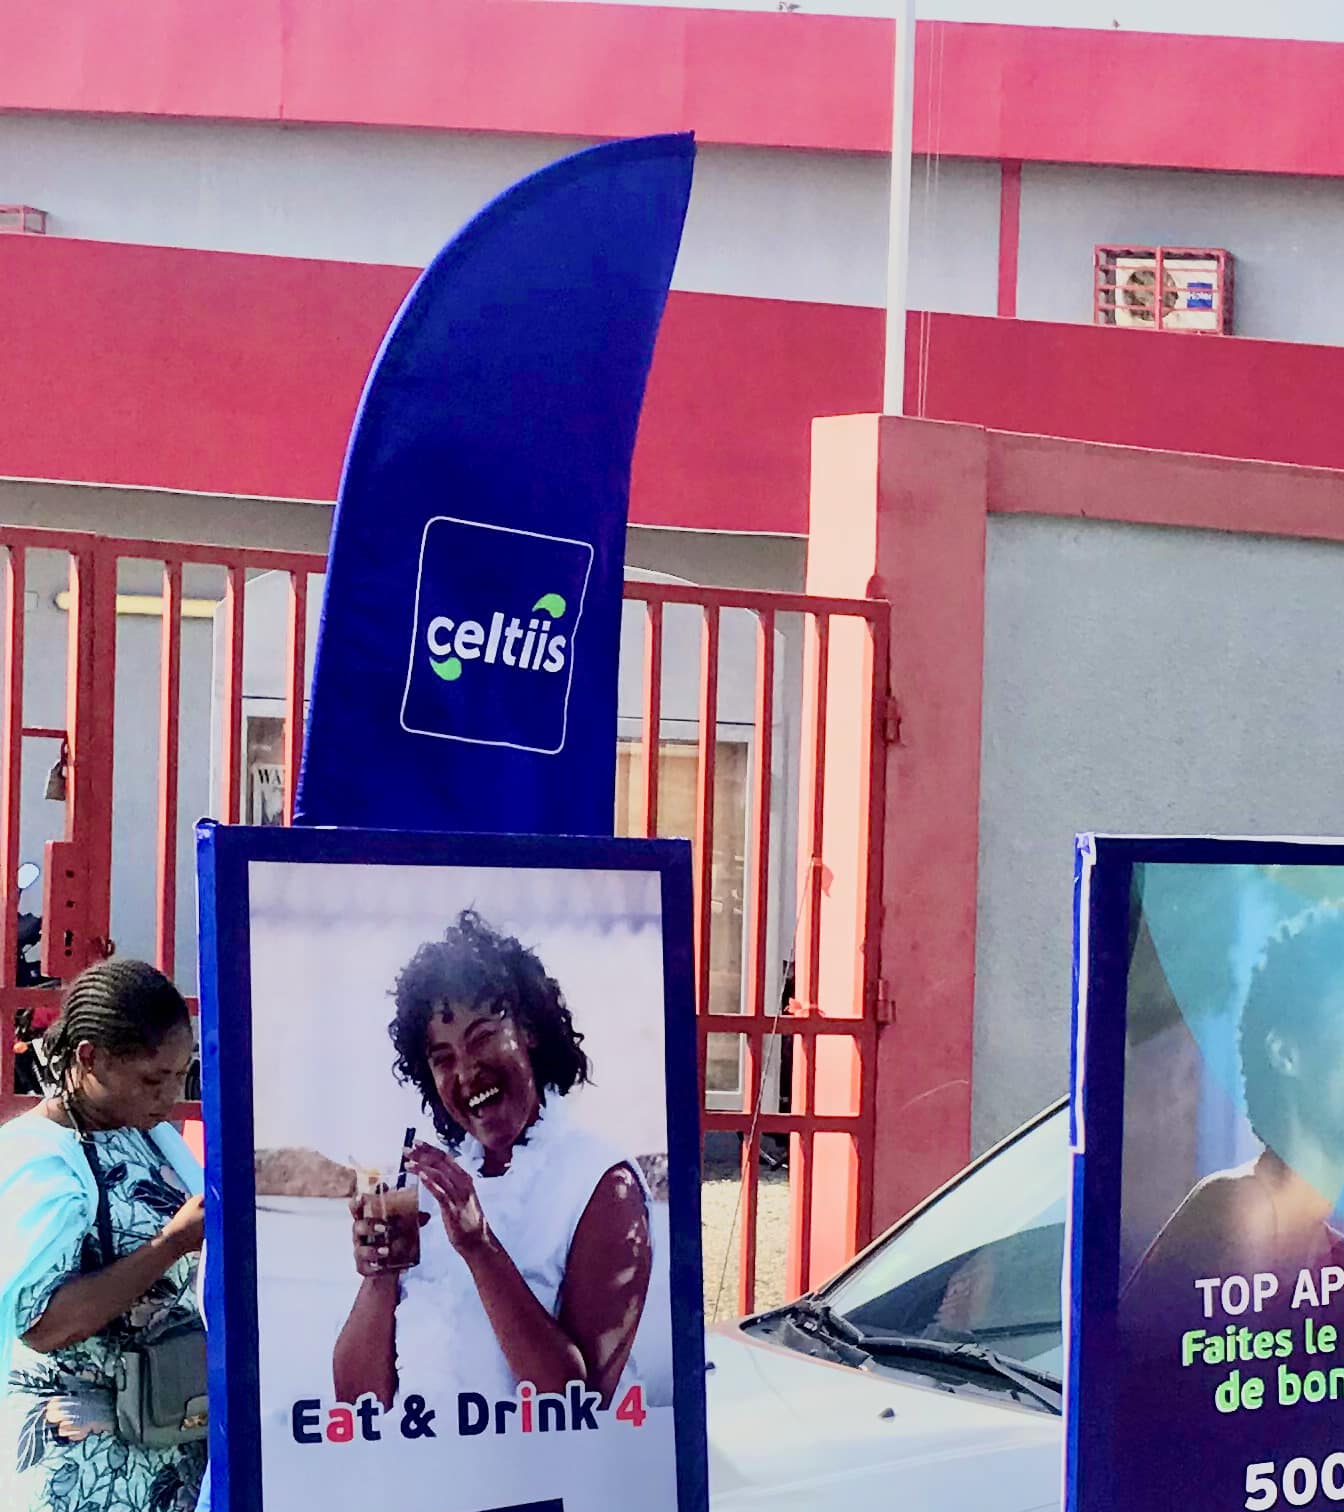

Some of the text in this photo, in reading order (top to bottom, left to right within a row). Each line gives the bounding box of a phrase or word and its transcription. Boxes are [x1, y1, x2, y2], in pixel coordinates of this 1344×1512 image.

[427, 612, 567, 673] celtiis
[1195, 1272, 1278, 1318] TOP
[1181, 1325, 1293, 1367] Faites
[1305, 1321, 1336, 1355] le
[291, 1381, 647, 1444] Eat & Drink 4
[1215, 1371, 1264, 1414] de
